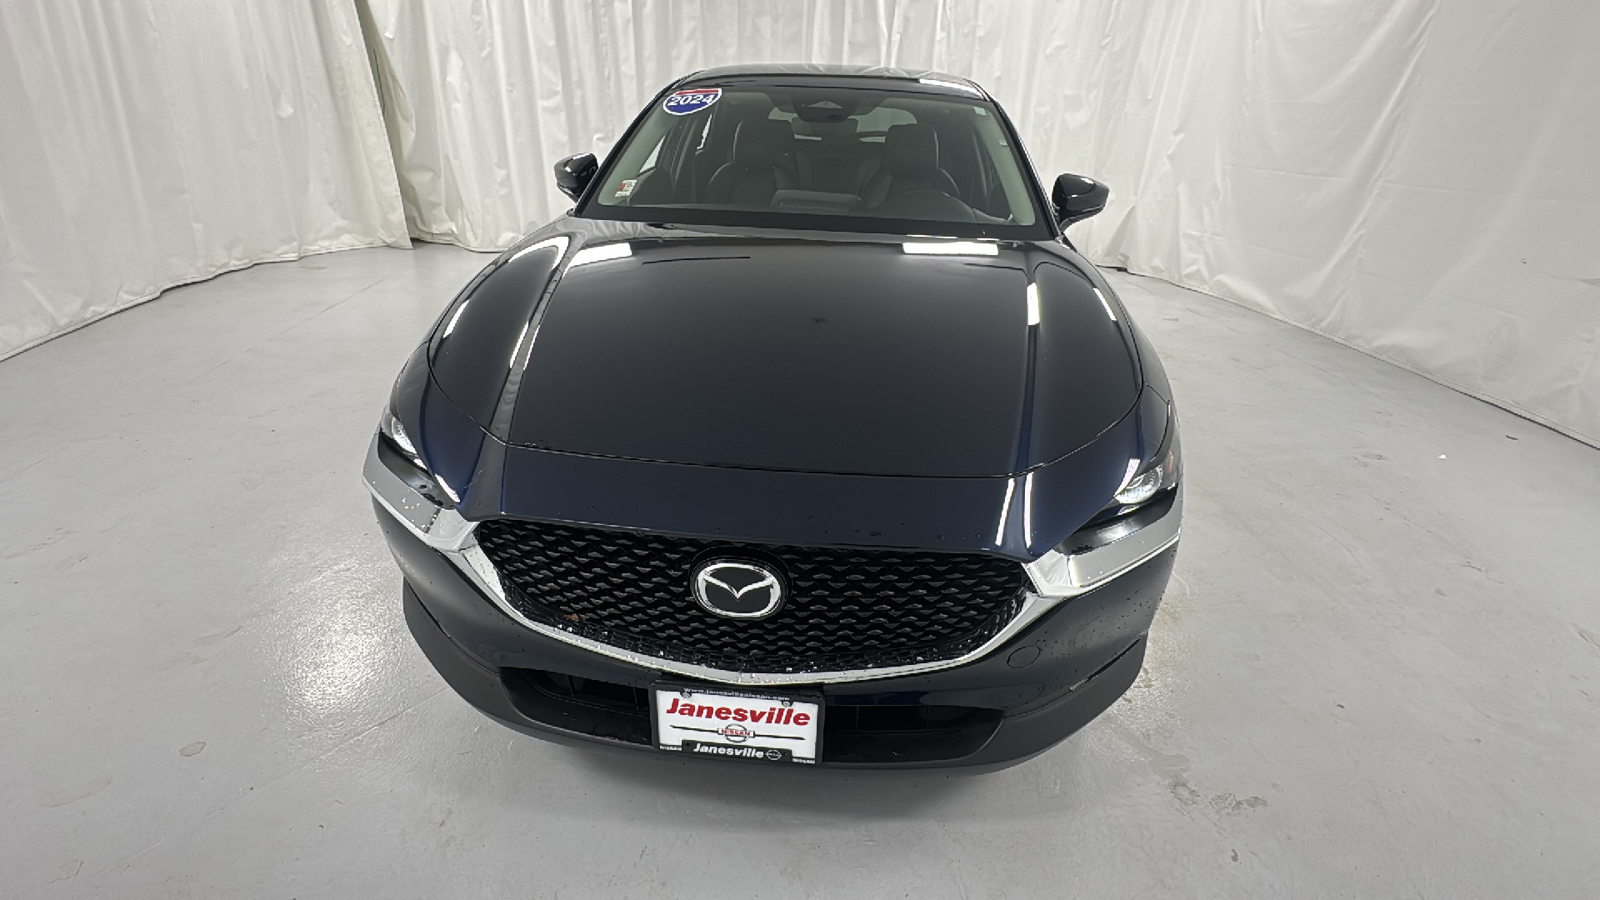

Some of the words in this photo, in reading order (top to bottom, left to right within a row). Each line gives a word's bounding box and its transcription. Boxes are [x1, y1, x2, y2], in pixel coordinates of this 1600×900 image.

[667, 94, 715, 106] 2024
[666, 697, 811, 726] Janesville
[721, 729, 751, 737] NISSAN
[693, 742, 764, 758] Janesville
